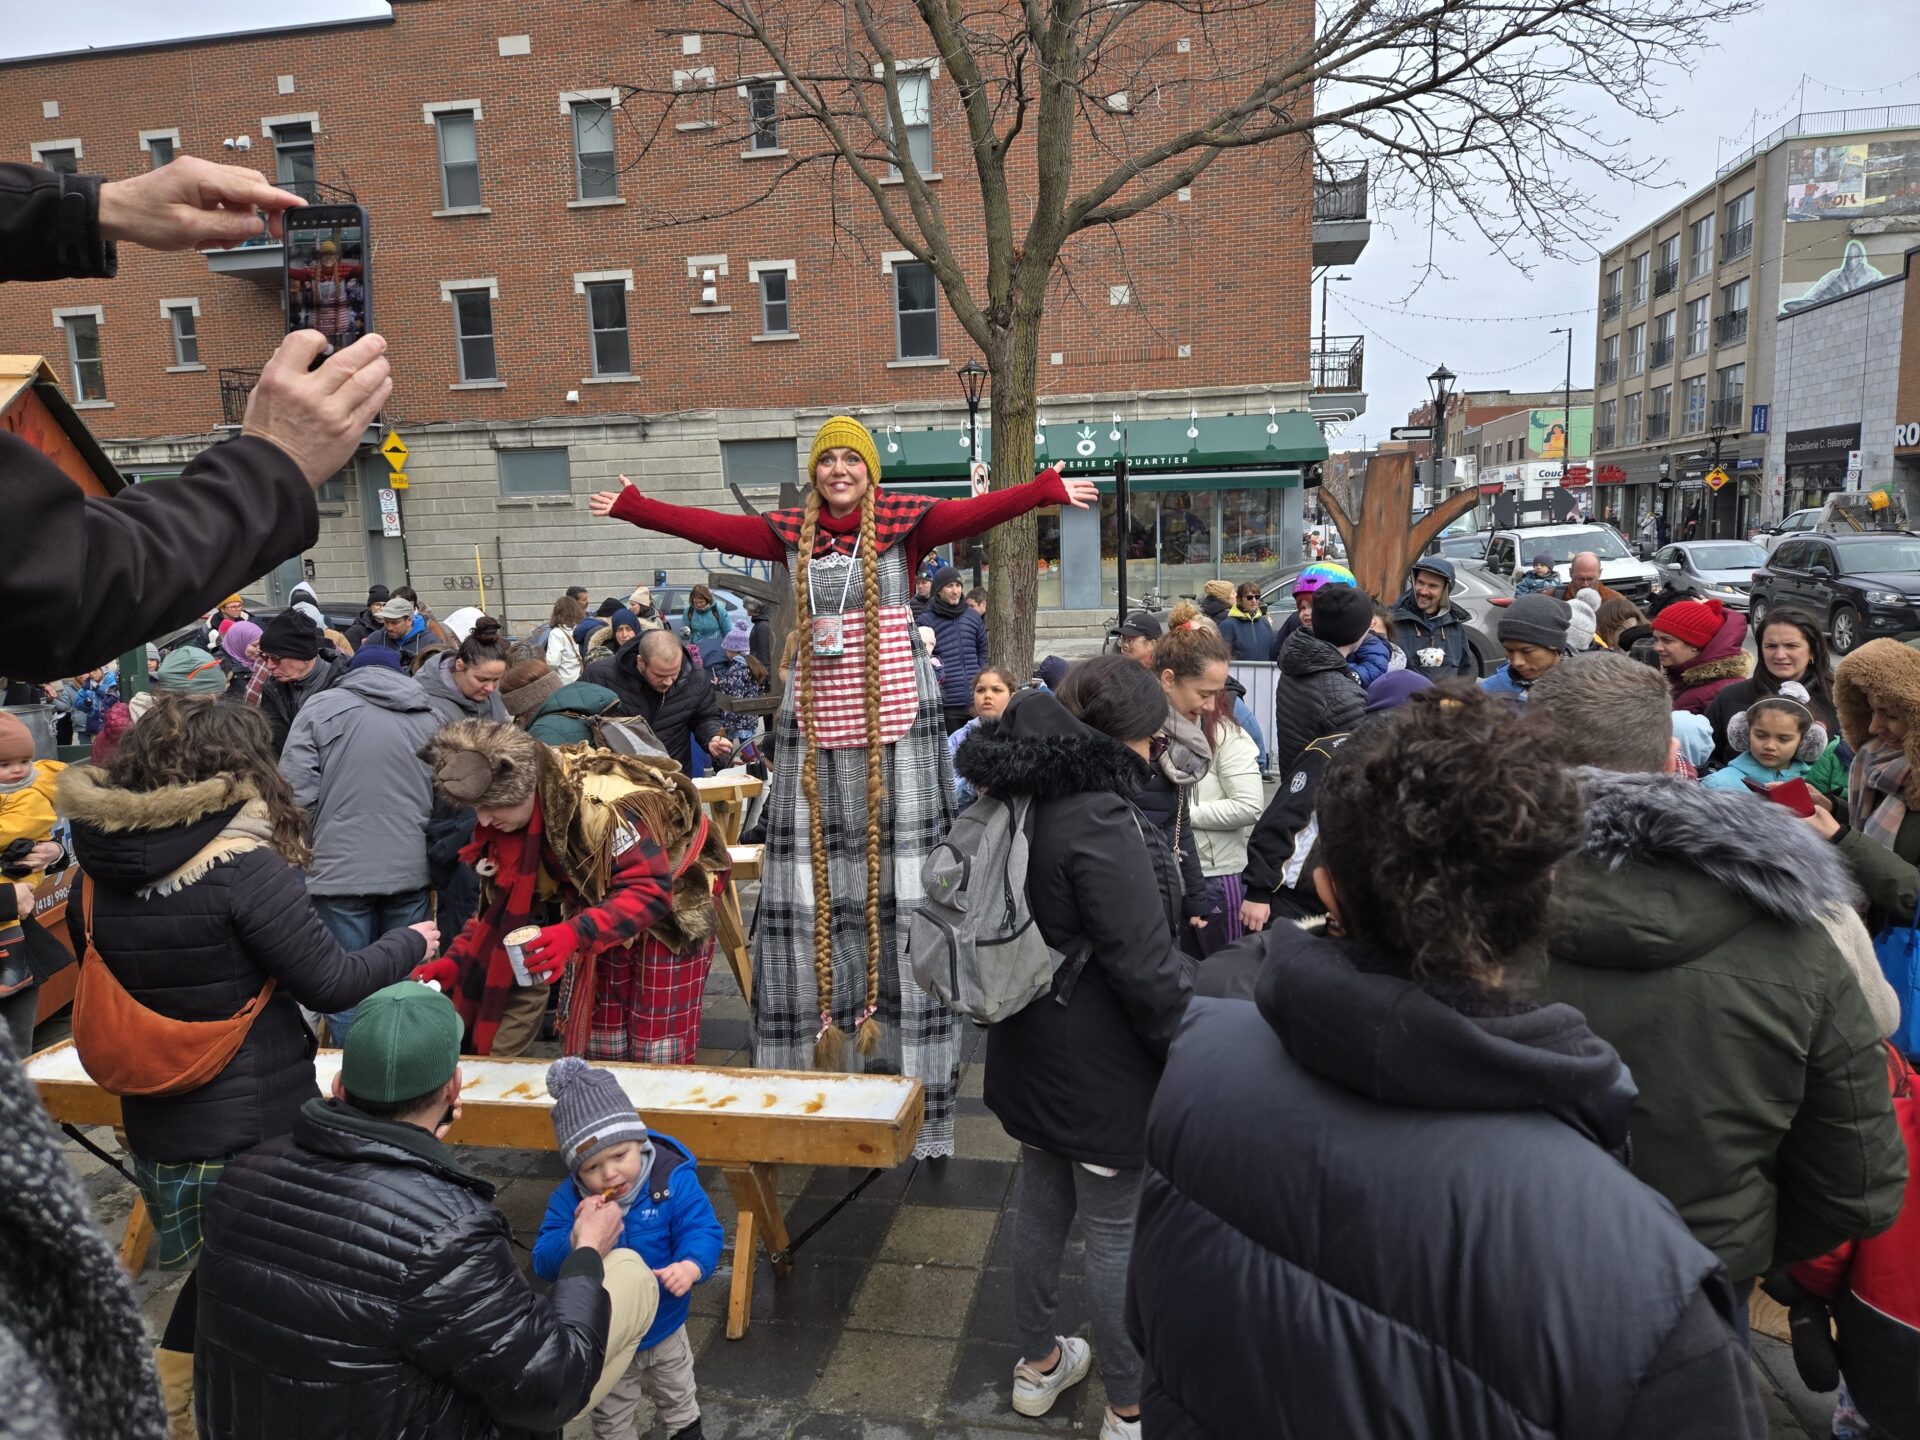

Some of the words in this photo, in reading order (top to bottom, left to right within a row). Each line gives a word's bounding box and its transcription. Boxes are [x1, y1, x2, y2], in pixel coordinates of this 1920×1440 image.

[1787, 441, 1820, 452] Quincaillerie
[1827, 437, 1854, 449] Bélanger
[1127, 456, 1189, 467] QUARTIER
[36, 894, 54, 914] (418)
[54, 885, 71, 901] 990-
